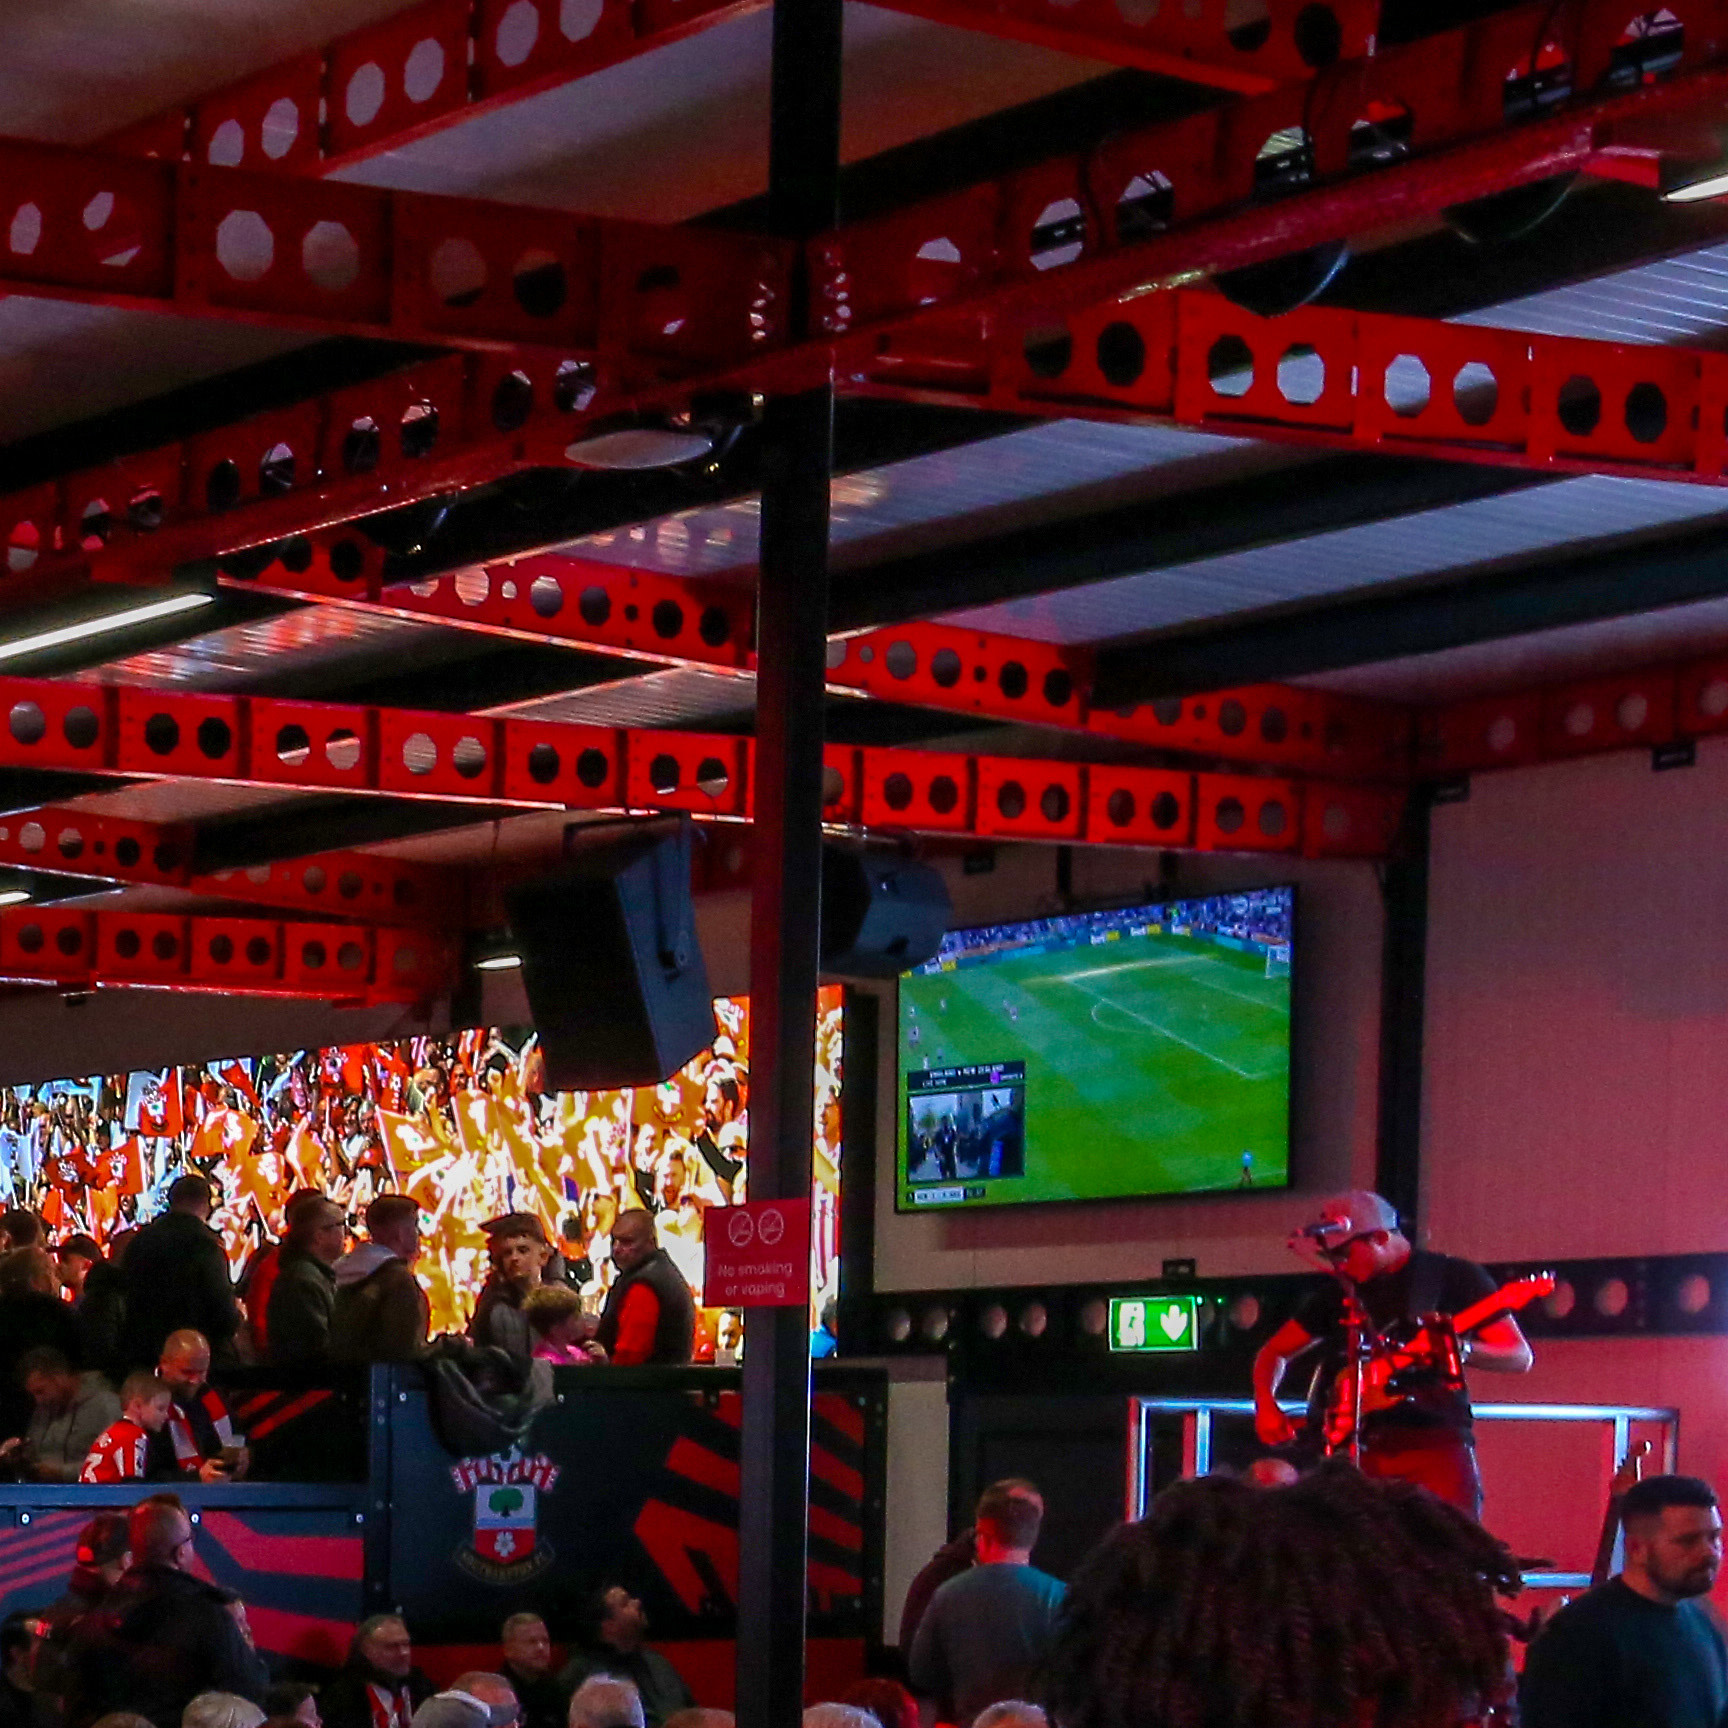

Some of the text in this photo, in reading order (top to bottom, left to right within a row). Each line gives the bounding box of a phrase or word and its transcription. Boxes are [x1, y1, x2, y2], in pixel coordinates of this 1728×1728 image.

[718, 1260, 793, 1278] No smoking
[725, 1282, 786, 1298] or vaping
